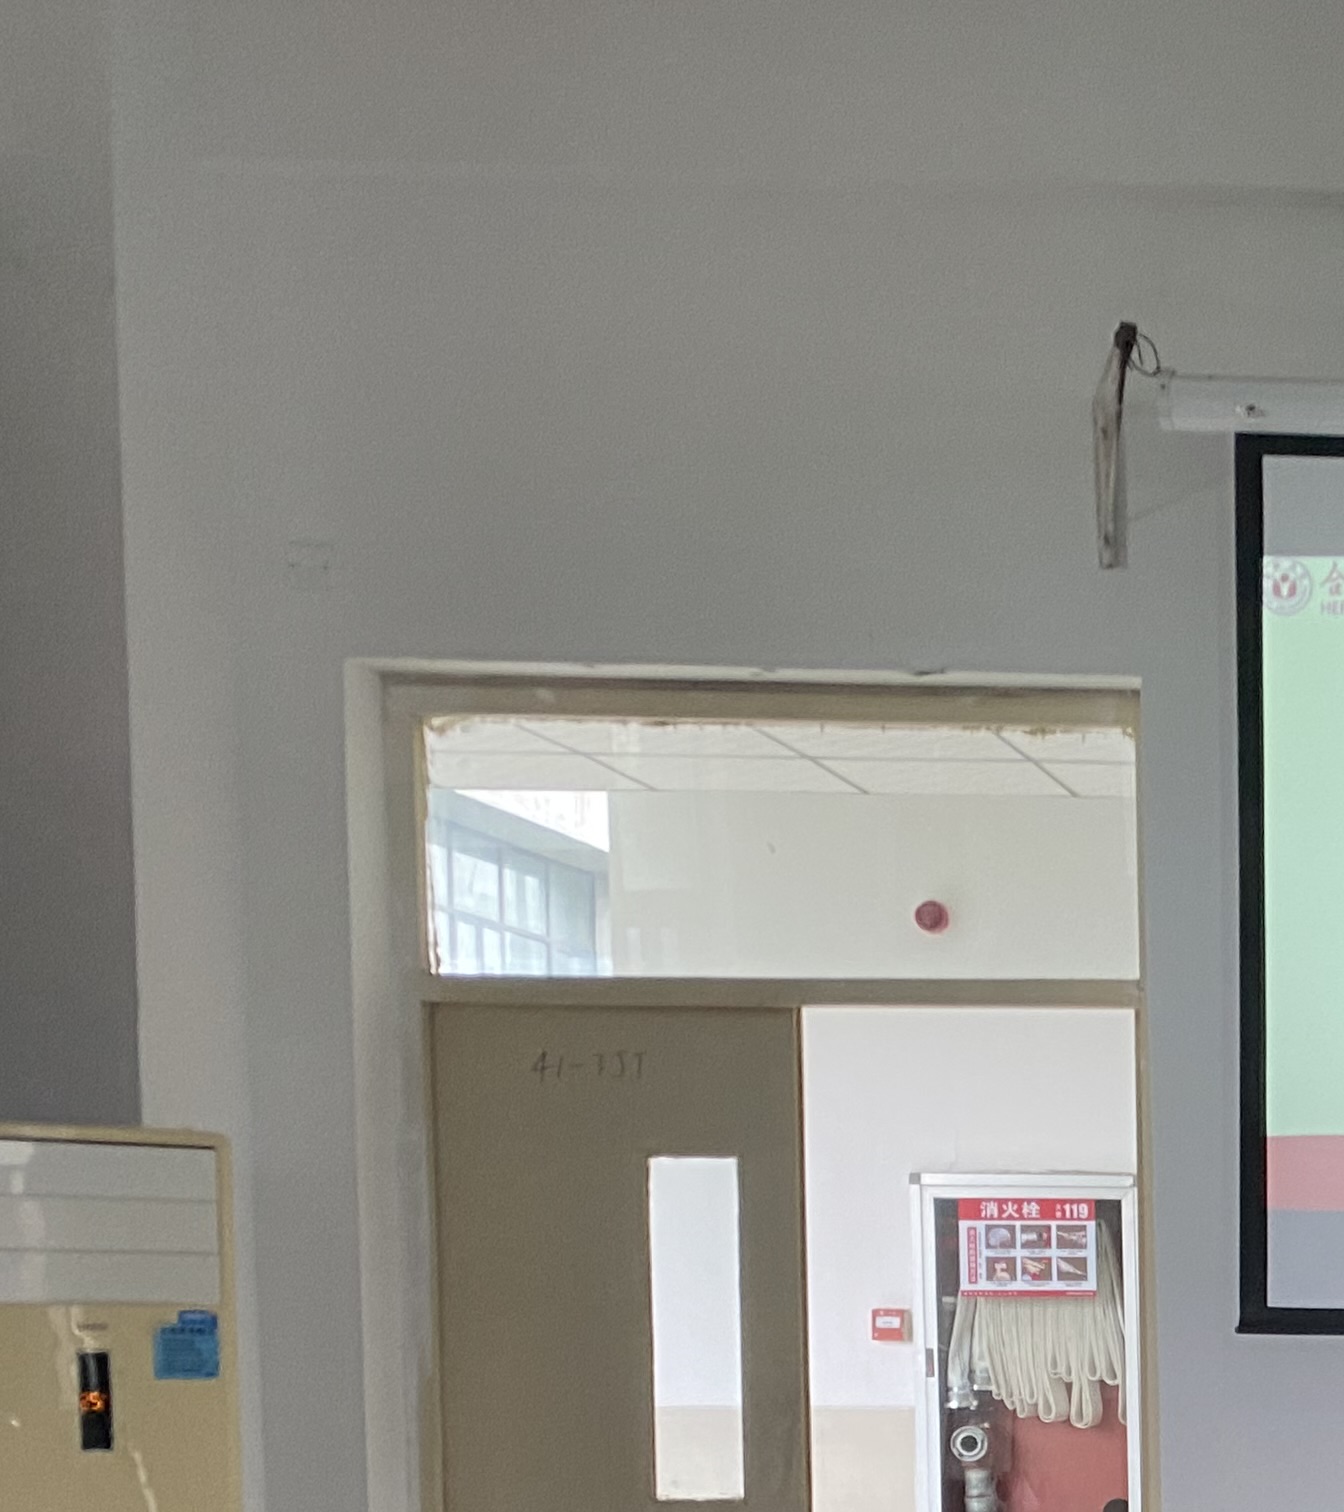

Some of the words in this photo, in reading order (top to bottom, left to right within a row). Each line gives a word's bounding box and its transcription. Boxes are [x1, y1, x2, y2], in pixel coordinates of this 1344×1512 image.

[980, 1201, 1040, 1219] 消火栓
[1062, 1203, 1088, 1219] 119
